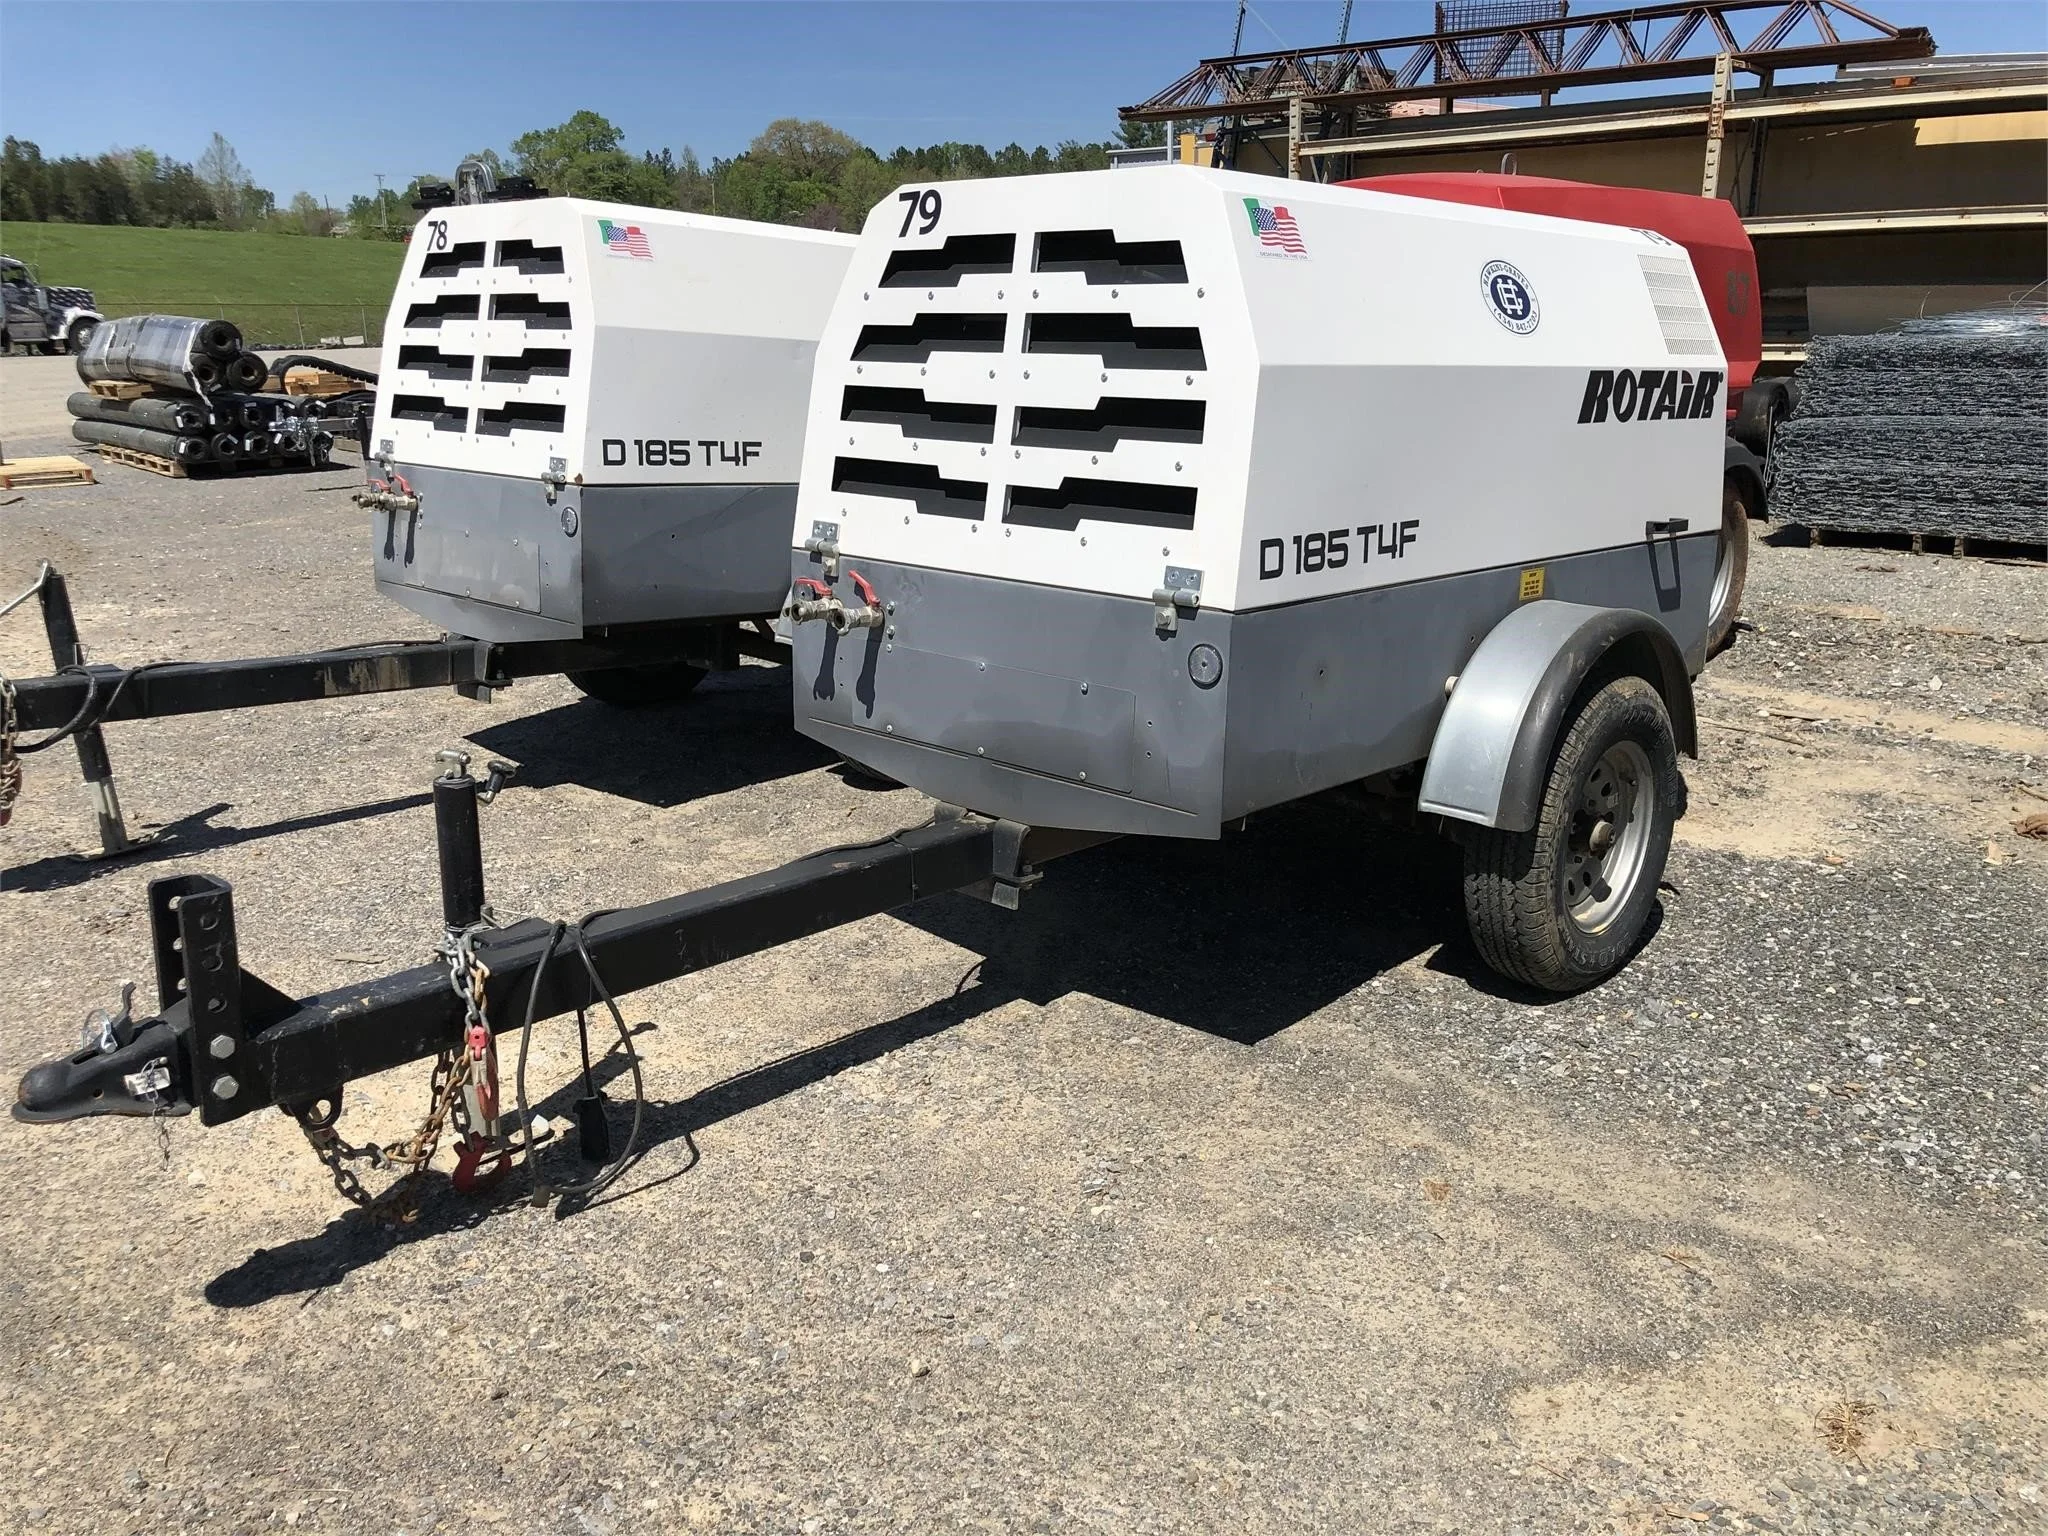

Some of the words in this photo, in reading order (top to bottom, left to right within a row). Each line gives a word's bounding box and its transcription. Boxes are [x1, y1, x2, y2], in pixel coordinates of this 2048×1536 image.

[899, 189, 942, 238] 79
[427, 220, 448, 251] 78
[602, 439, 626, 466] D
[634, 440, 690, 466] 185
[698, 441, 762, 466] T4F
[1260, 538, 1284, 580] D
[1293, 528, 1349, 574] 185
[1357, 519, 1419, 563] T4F
